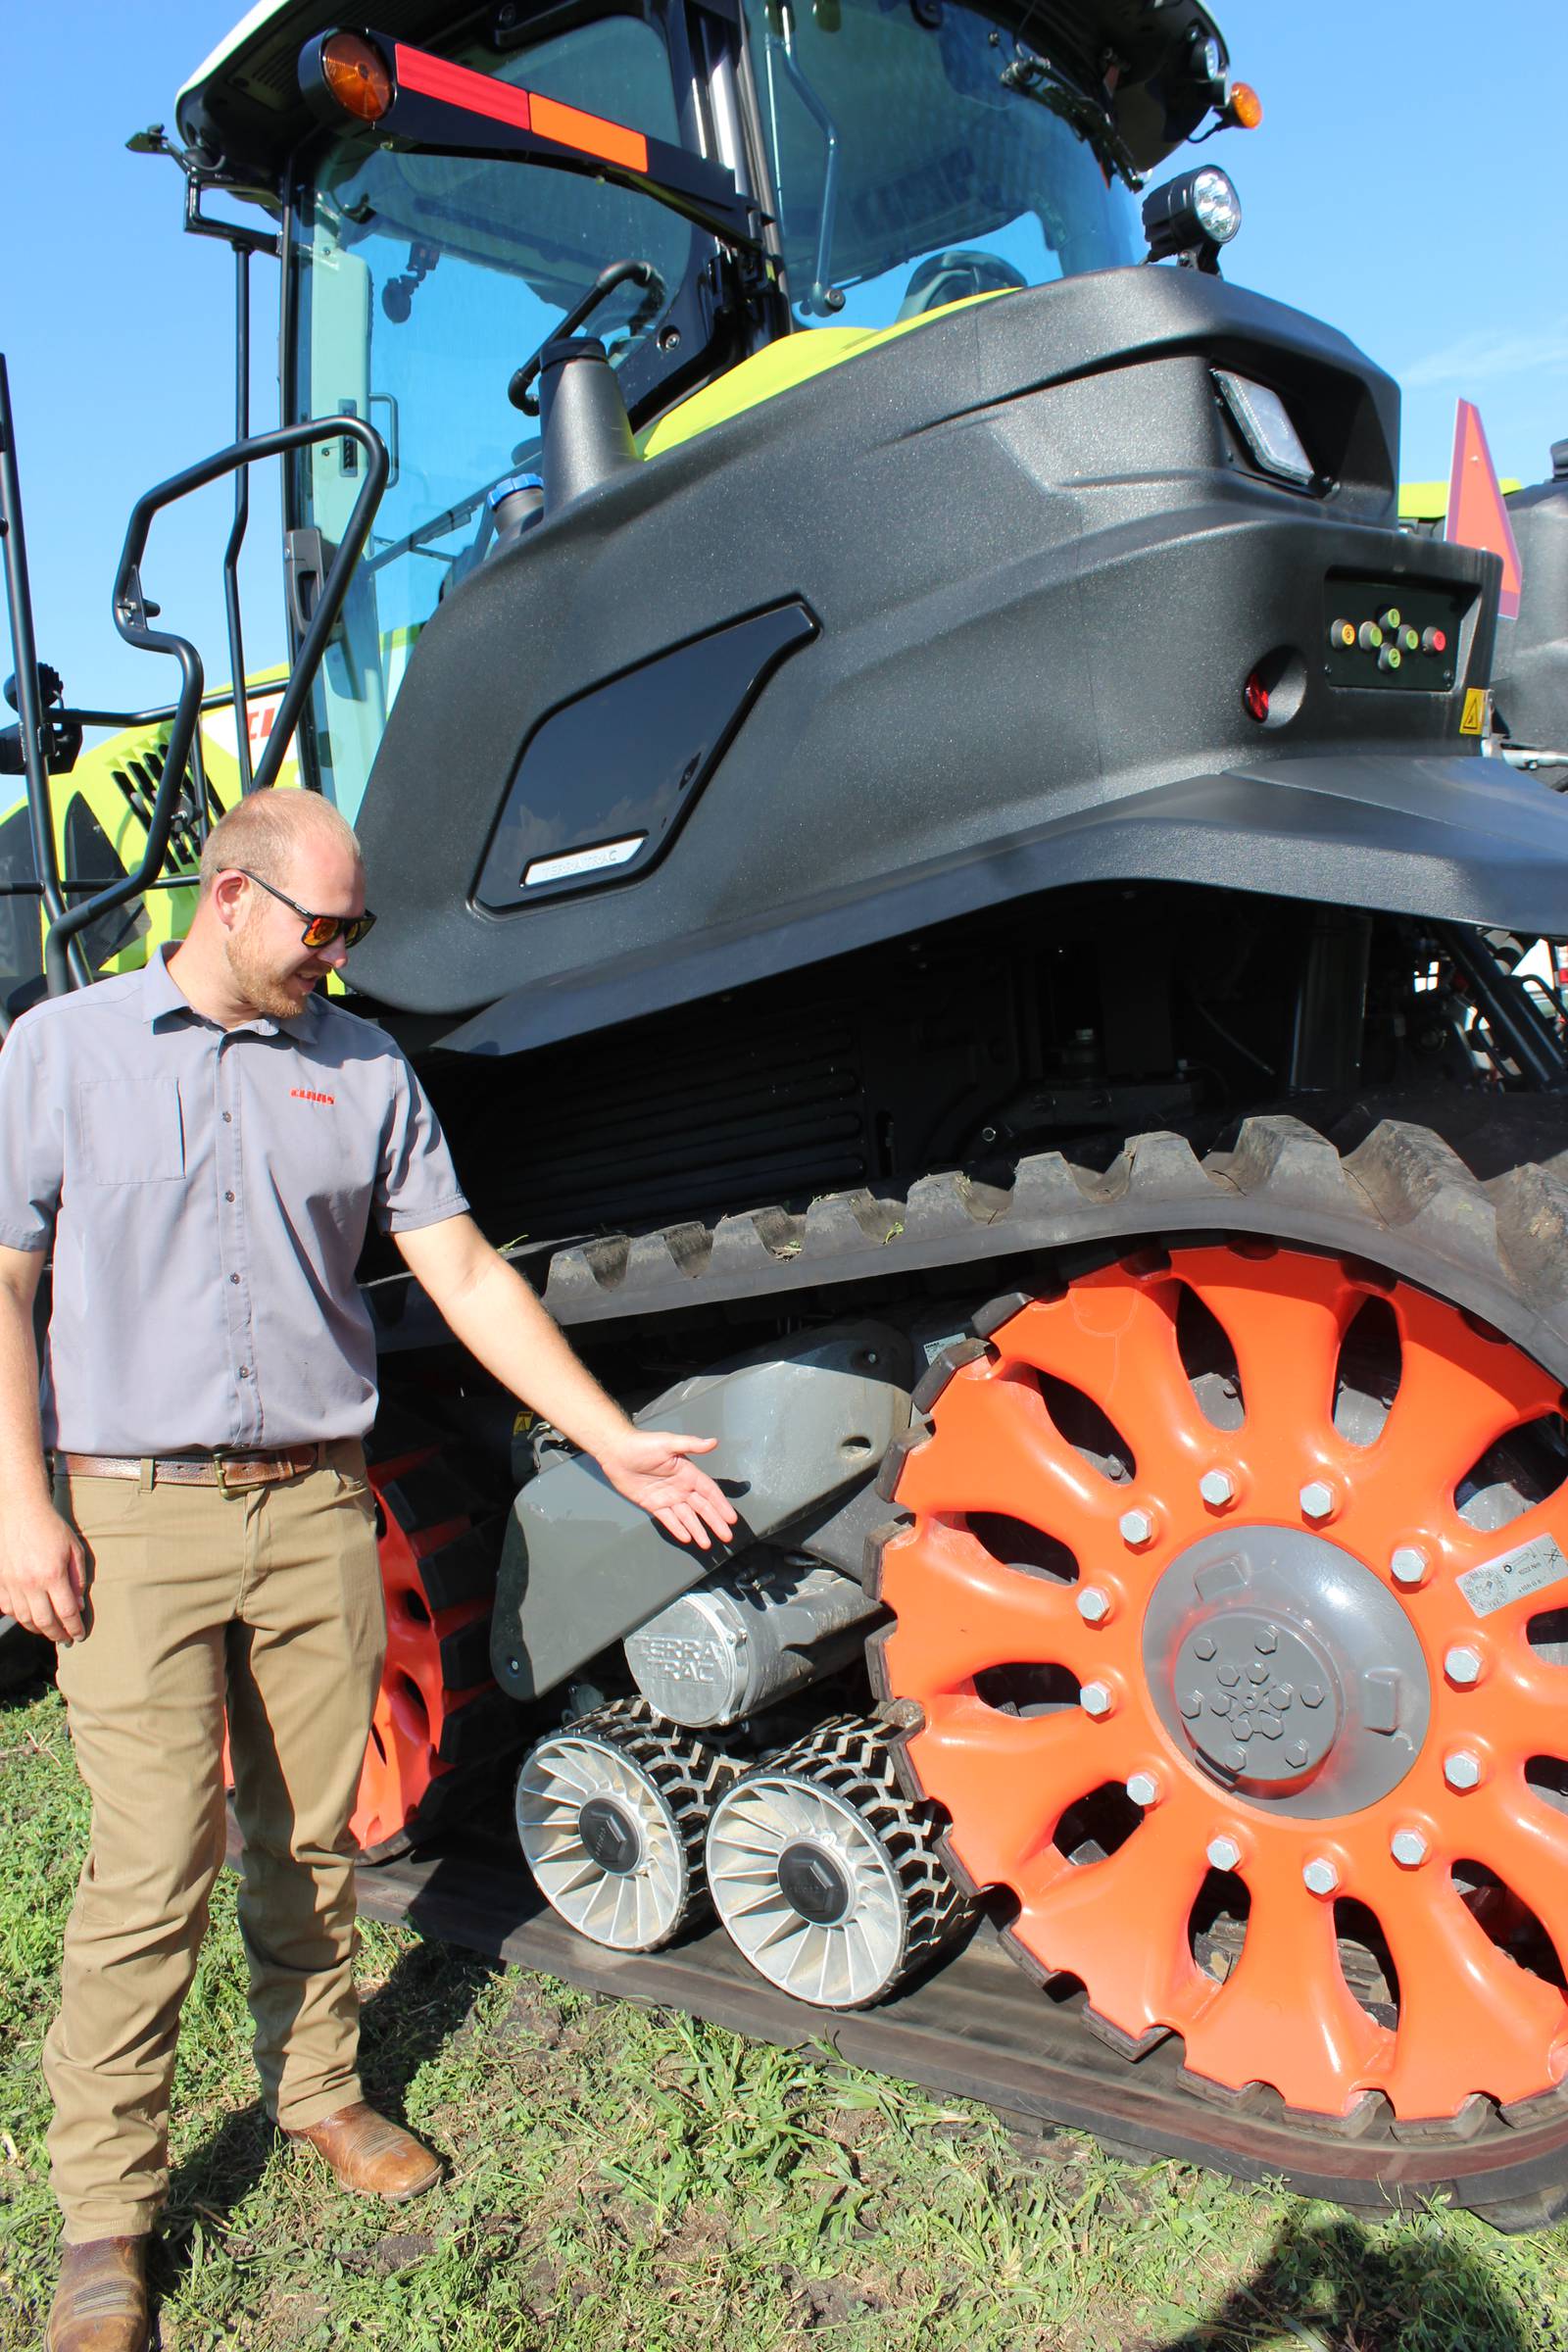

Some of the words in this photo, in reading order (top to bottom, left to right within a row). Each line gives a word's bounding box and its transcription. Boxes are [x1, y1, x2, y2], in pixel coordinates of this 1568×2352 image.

[289, 1088, 335, 1105] CLAAS
[632, 1634, 722, 1661] TERRA
[647, 1658, 714, 1683] TRAC
